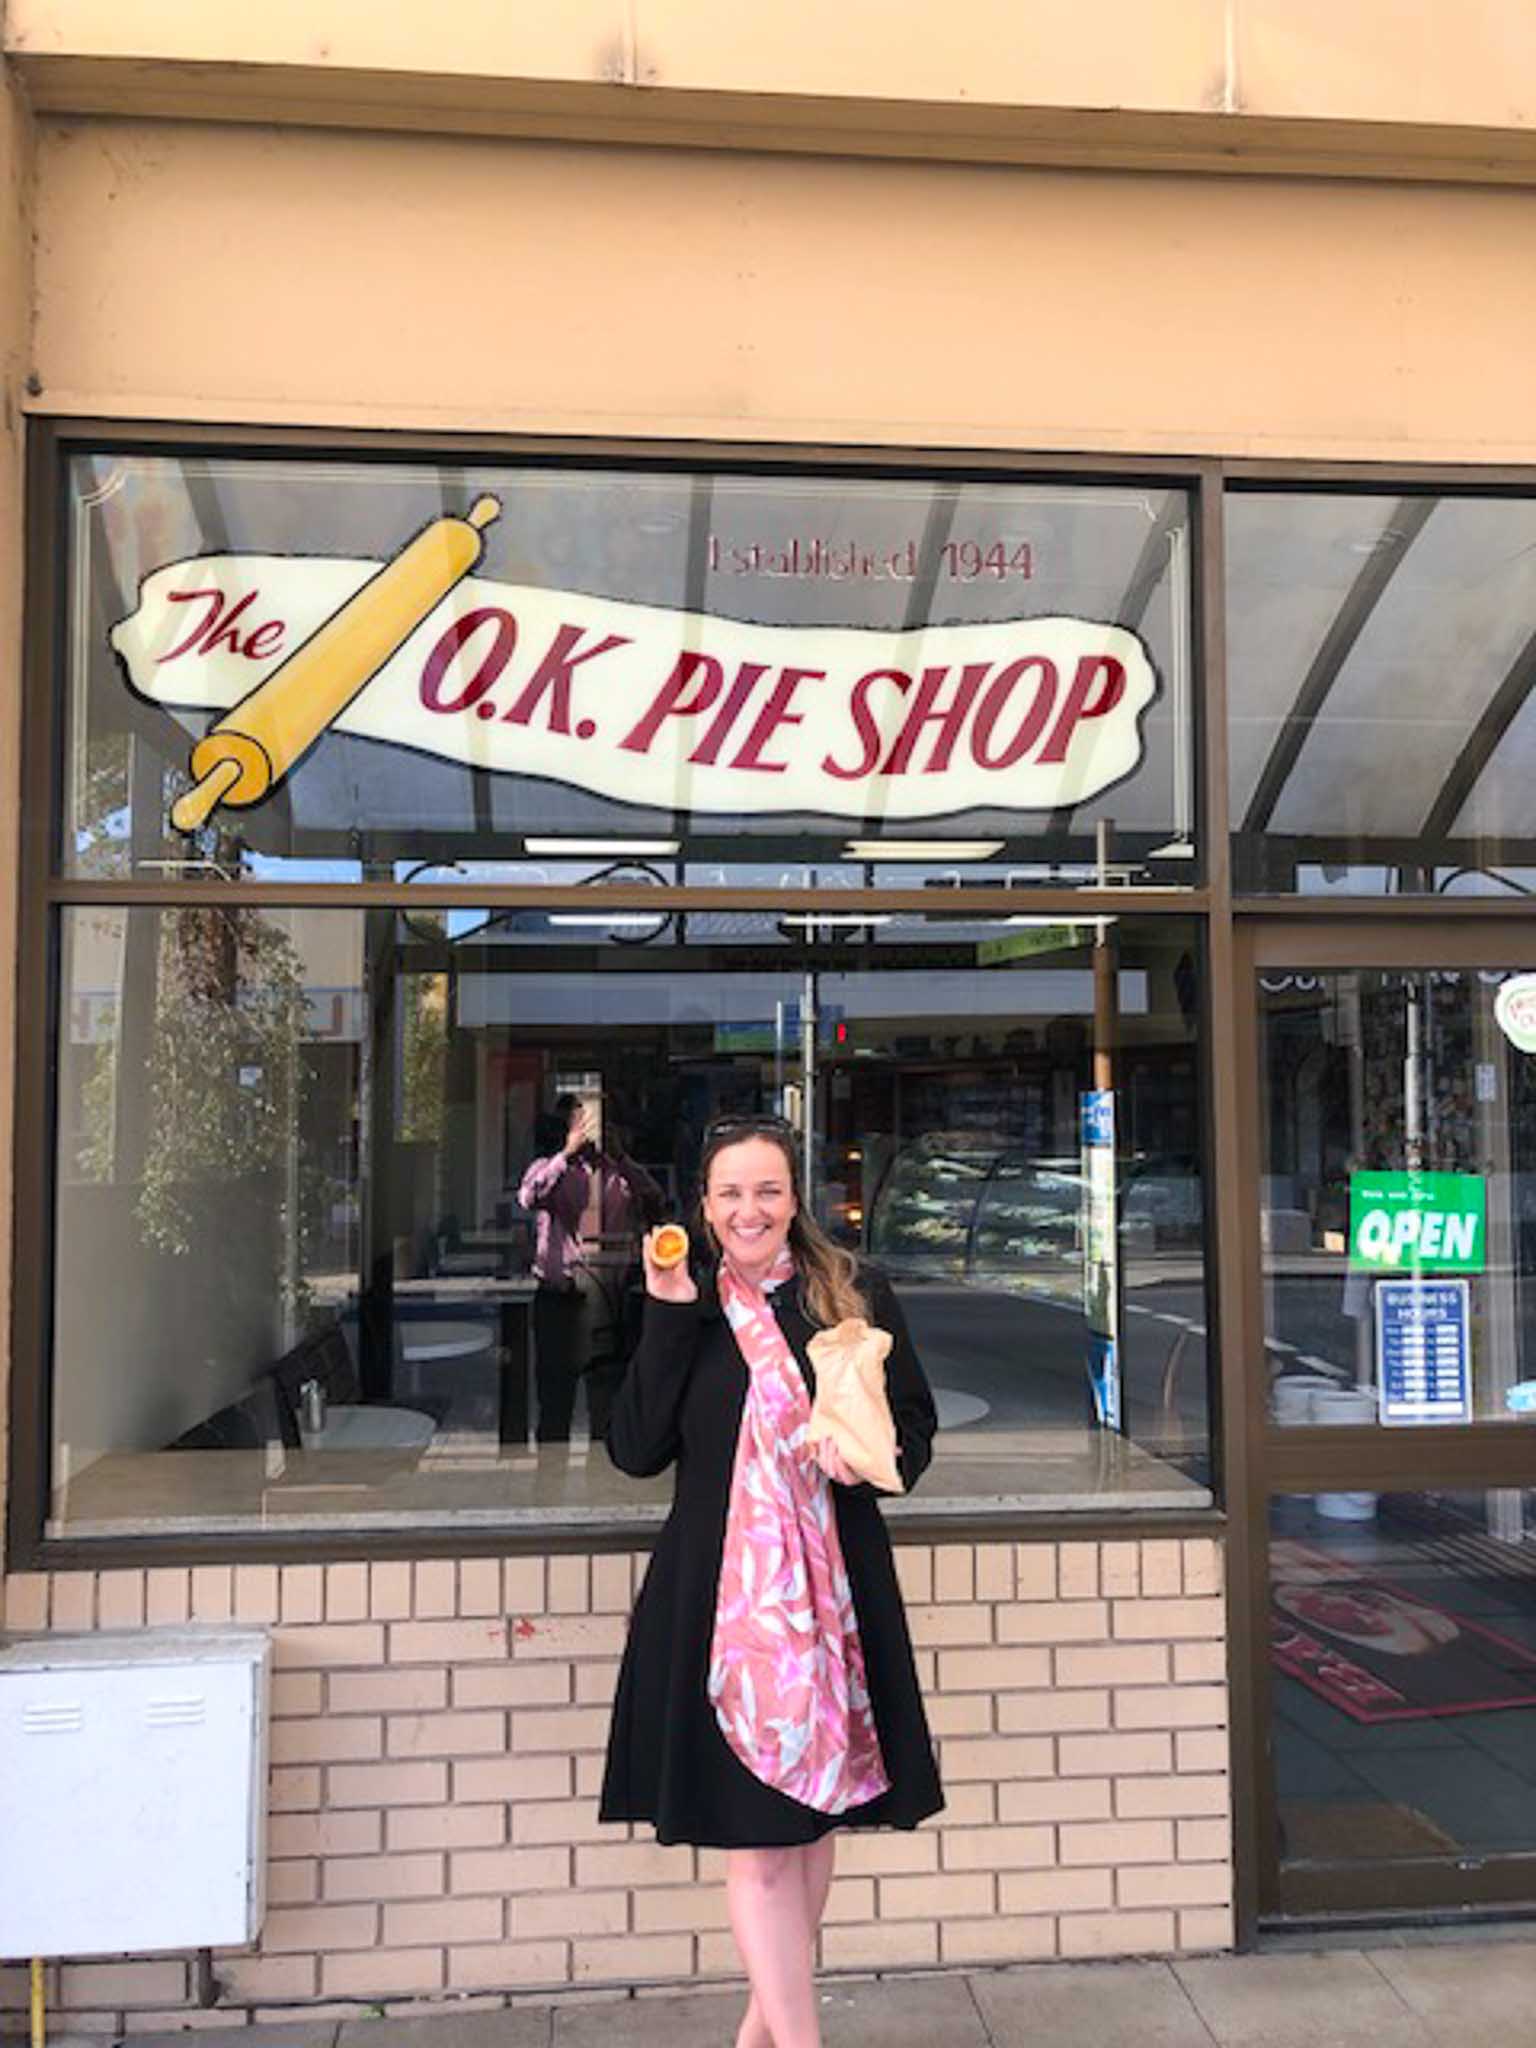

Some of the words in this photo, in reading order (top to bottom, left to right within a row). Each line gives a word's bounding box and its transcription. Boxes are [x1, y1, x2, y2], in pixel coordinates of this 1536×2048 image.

[940, 540, 1032, 580] 1944
[155, 587, 286, 664] The
[419, 606, 635, 740] O.K.
[617, 650, 828, 774] PIE
[820, 654, 1129, 782] SHOP
[1357, 1209, 1479, 1264] OPEN
